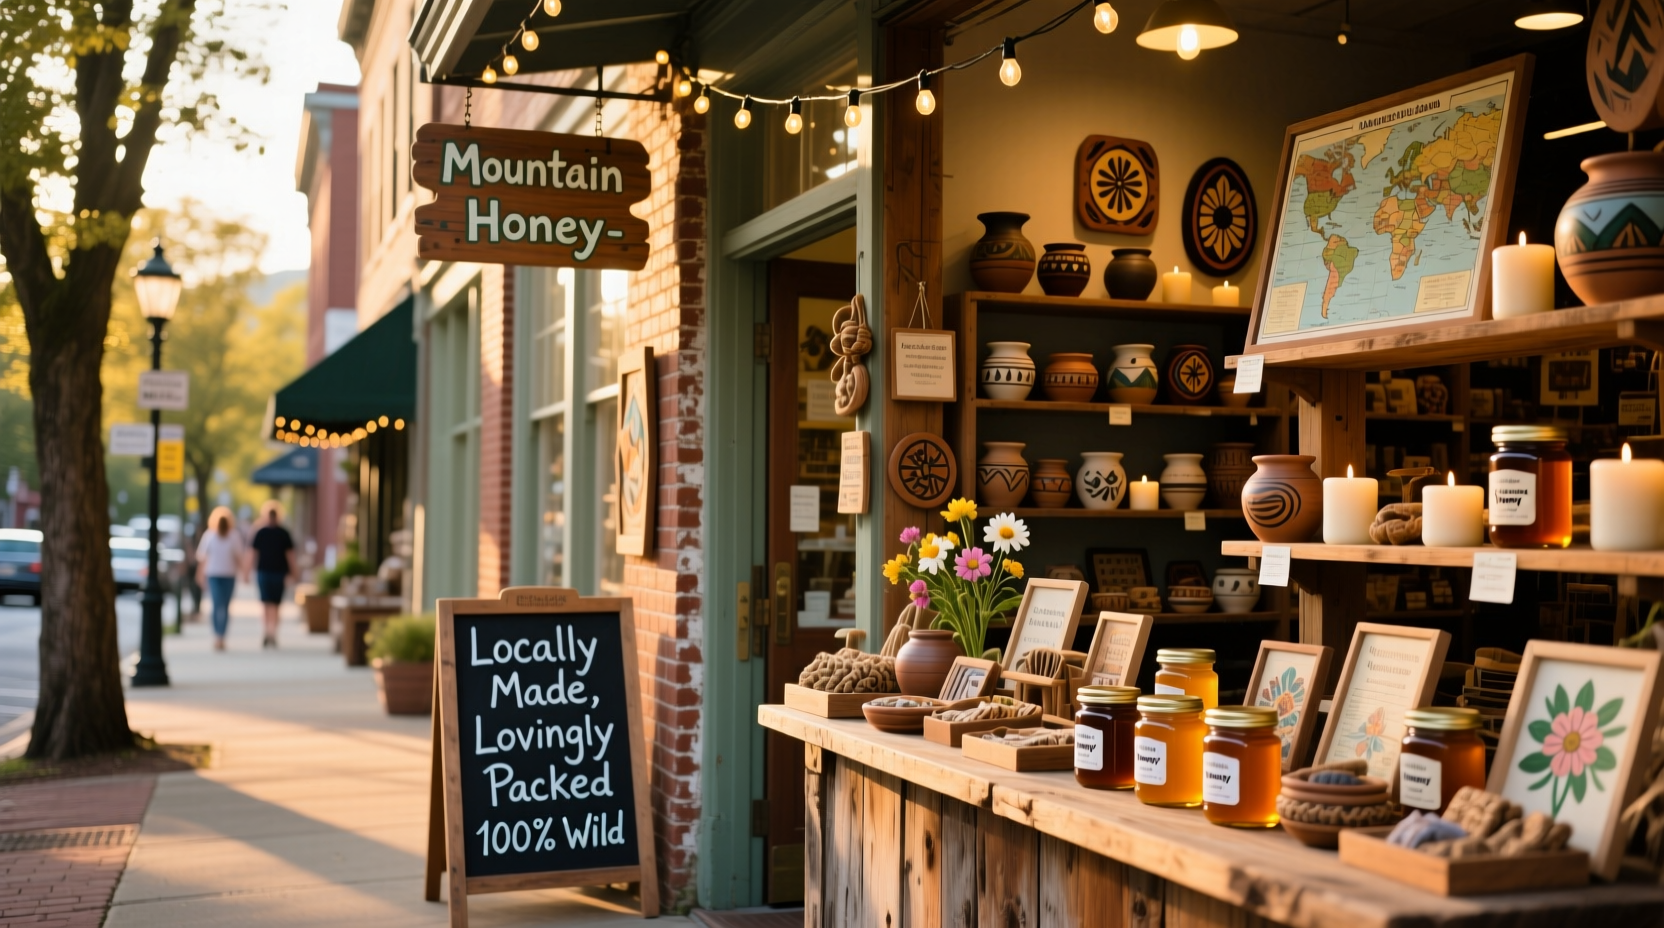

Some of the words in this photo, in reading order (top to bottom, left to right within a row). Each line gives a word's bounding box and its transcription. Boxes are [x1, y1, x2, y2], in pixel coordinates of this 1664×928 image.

[442, 142, 623, 193] Mountain
[471, 624, 597, 676] Locally
[490, 668, 599, 708] Made,
[476, 714, 614, 765] Lovingly
[482, 761, 614, 807] Packed
[475, 817, 556, 856] 100%
[562, 809, 625, 850] Wild
